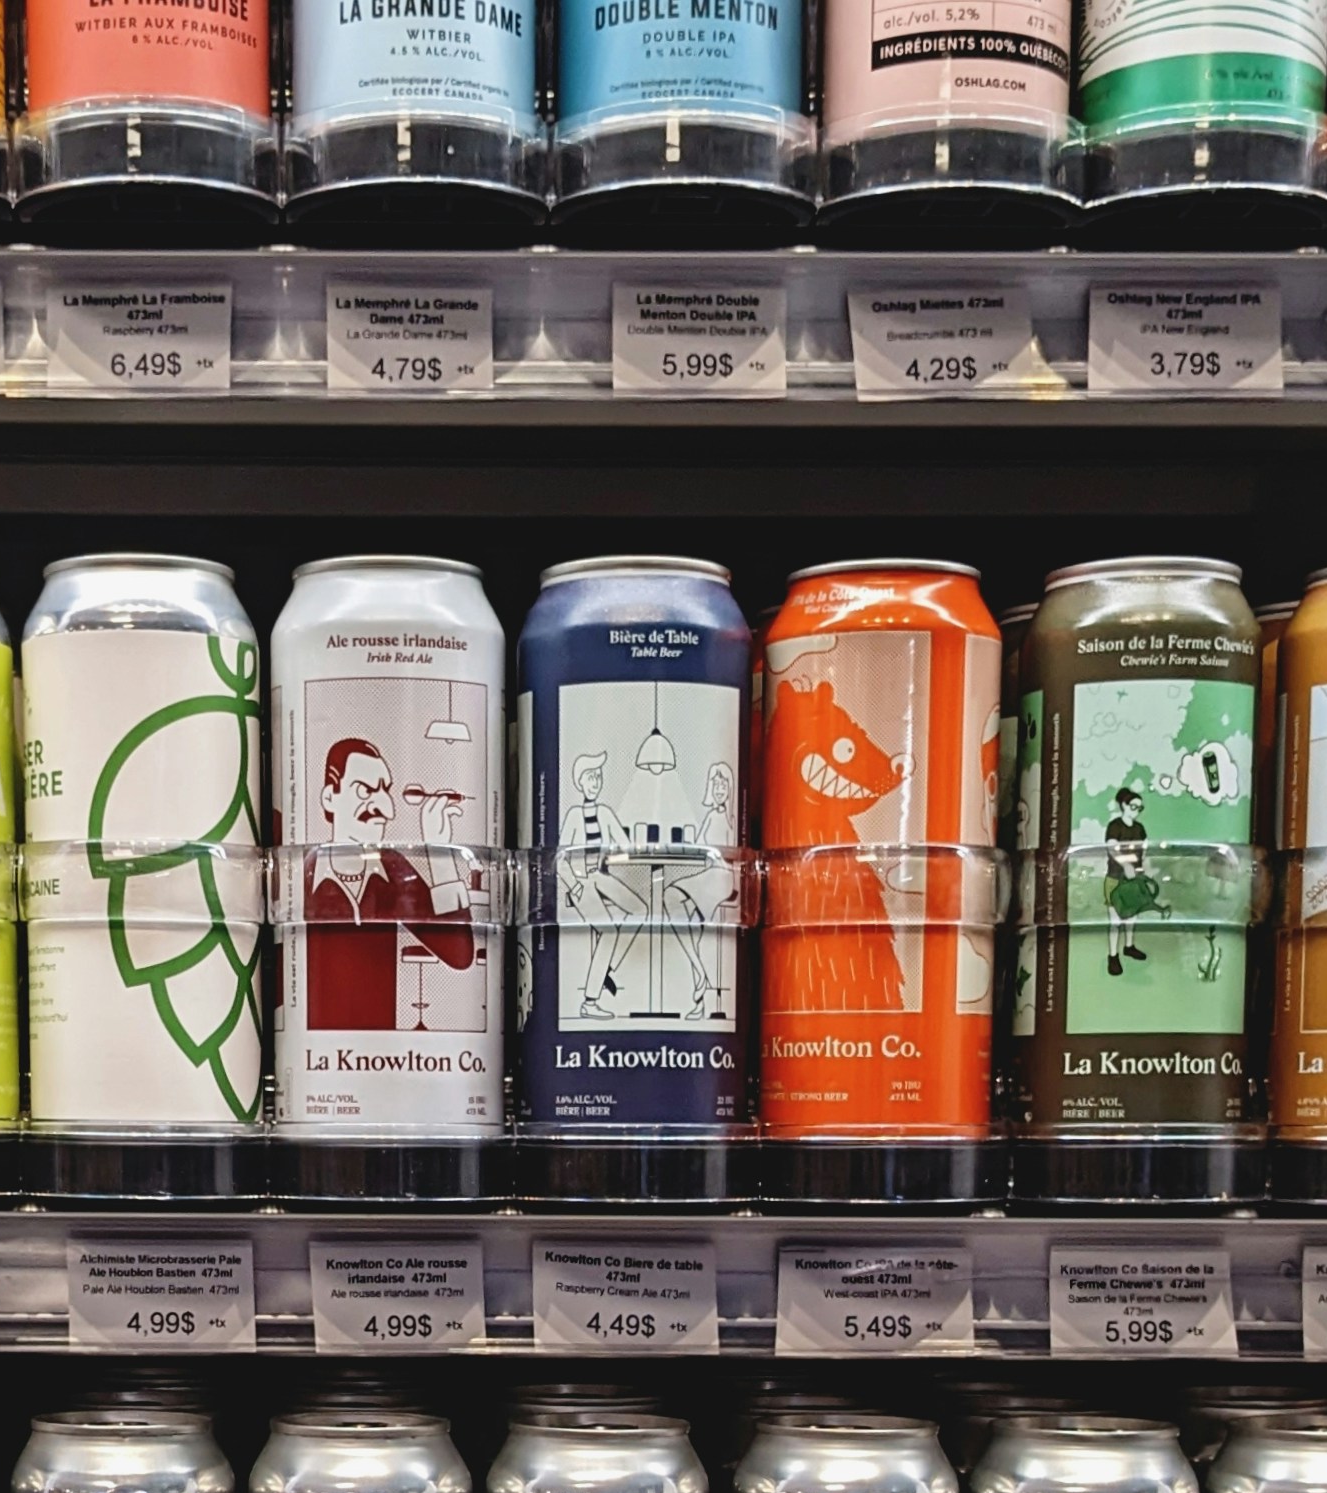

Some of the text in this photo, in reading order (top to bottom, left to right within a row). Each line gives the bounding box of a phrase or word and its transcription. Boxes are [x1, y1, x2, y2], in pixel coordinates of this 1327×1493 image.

[75, 17, 257, 48] WITBIER AUX FRAMBOISES
[475, 3, 523, 38] DAME
[406, 28, 472, 44] WITBIER
[643, 30, 736, 45] DOUBLE IPA
[879, 37, 1016, 60] INGRÉDIENTS 100%
[955, 76, 1027, 93] OSHLAG.COM
[110, 351, 182, 379] 6,49$
[371, 356, 442, 383] 4,79$
[905, 355, 977, 383] 4,29$
[327, 633, 468, 651] Ale rousse irlandaise
[609, 629, 698, 646] Bière de Table
[1077, 635, 1209, 655] Saison Ferme
[417, 653, 432, 664] Ale
[306, 1049, 487, 1073] La Knowlton Co.
[555, 1044, 735, 1069] La Knowlton Co.
[1099, 1050, 1214, 1076] Knowlton
[127, 1312, 196, 1336] 4,99$
[364, 1315, 432, 1340] 4,99$
[586, 1313, 656, 1338] 4,49$
